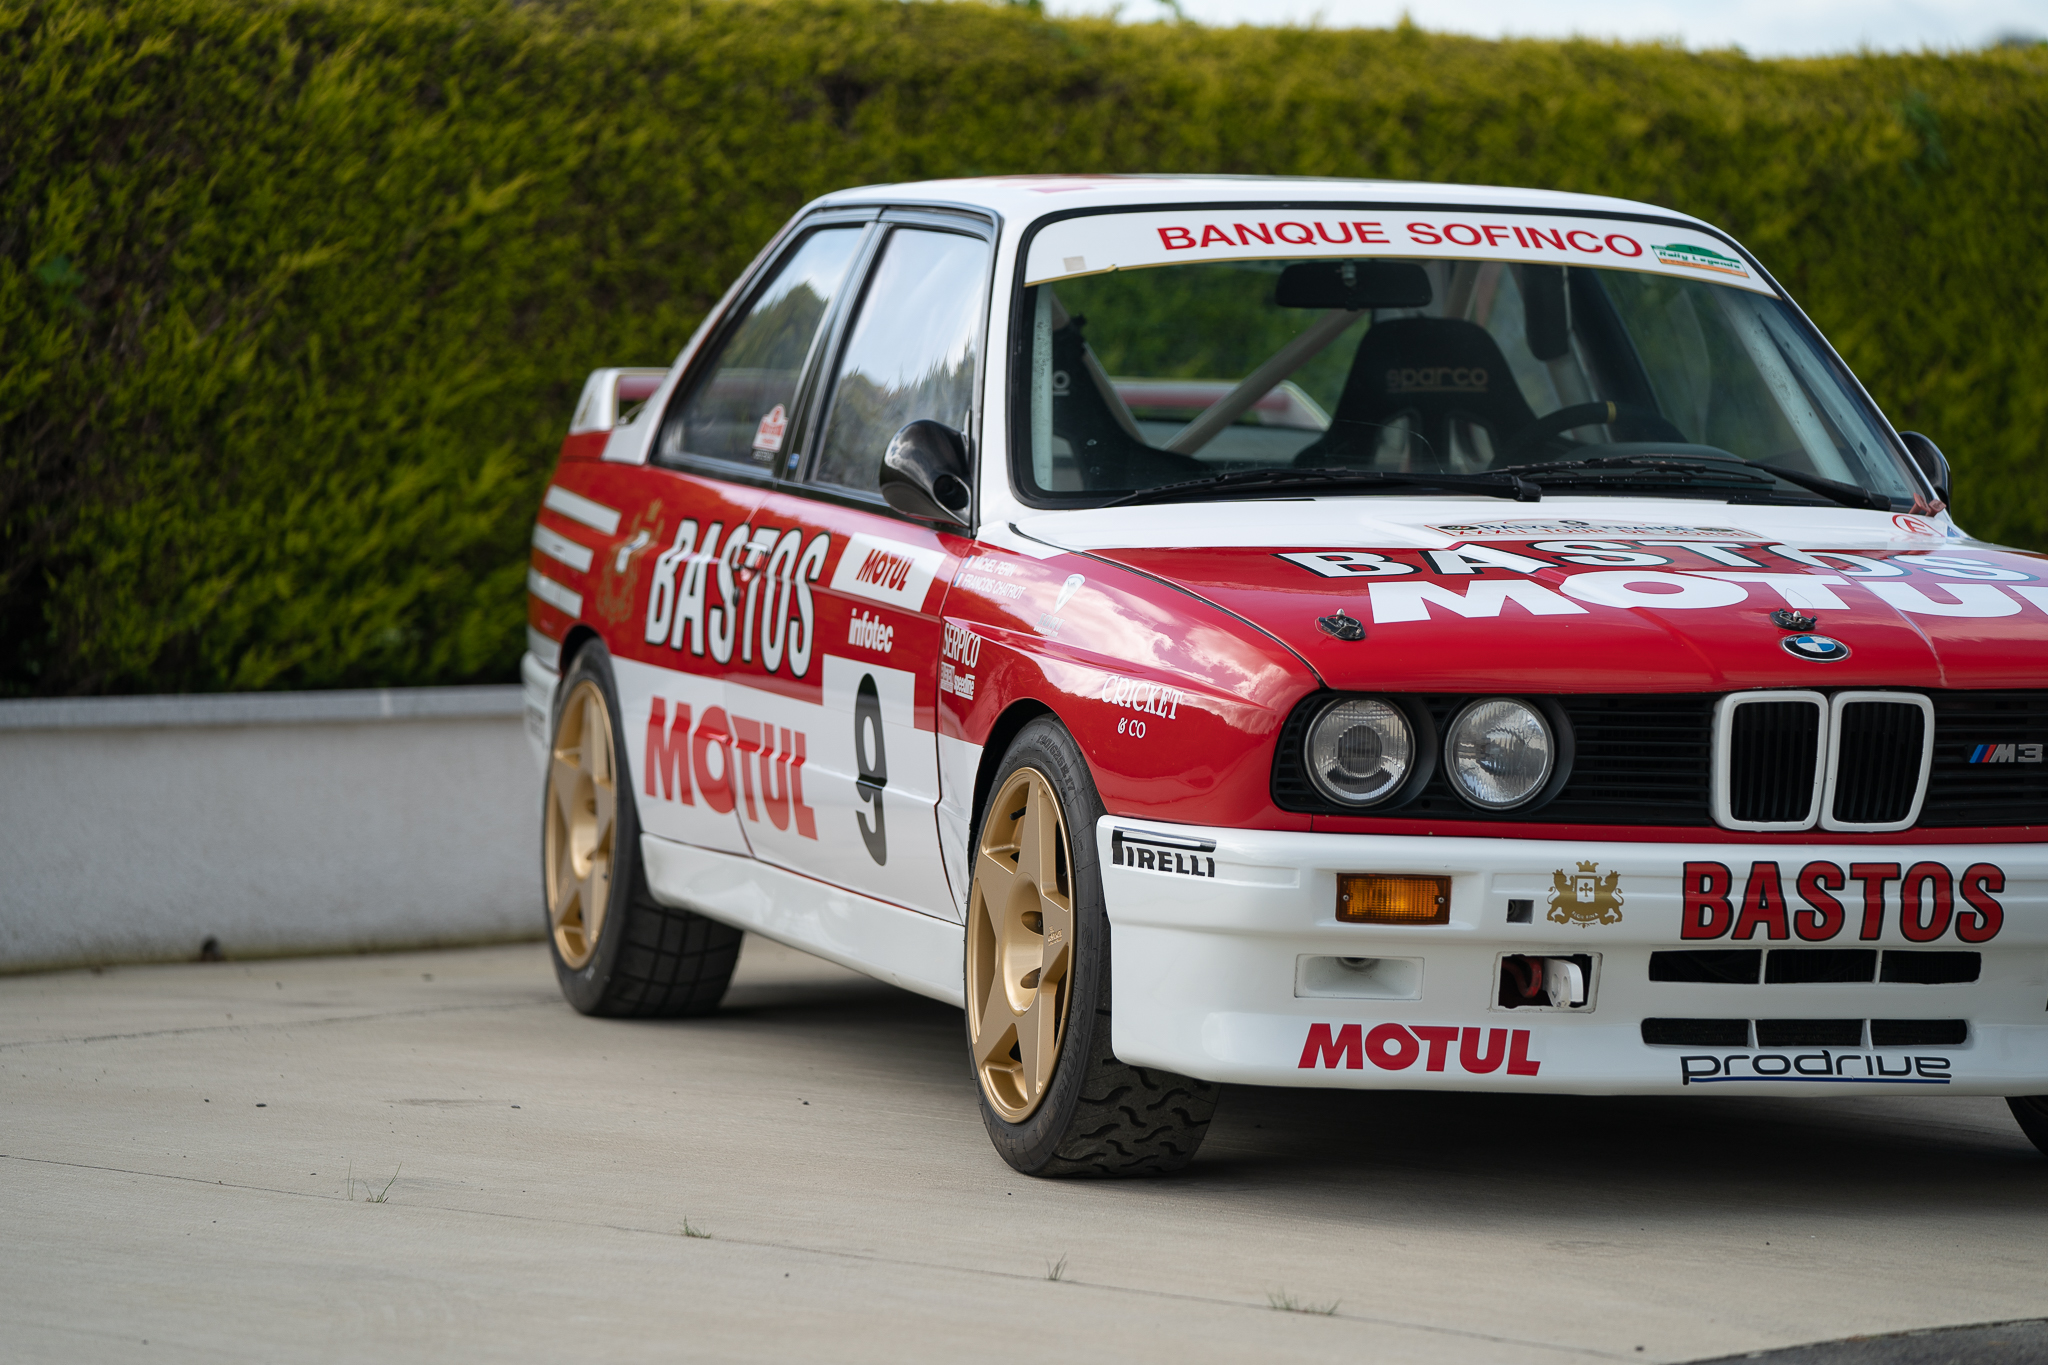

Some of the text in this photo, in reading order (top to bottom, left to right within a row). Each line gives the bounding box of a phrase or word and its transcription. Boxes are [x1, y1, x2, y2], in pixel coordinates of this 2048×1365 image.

[1156, 221, 1643, 258] BANQUE SOFINCO
[1386, 366, 1489, 392] sparco
[856, 548, 916, 592] MOTUL
[1274, 540, 2040, 582] BASTOS
[644, 518, 831, 679] BASTOS
[848, 608, 894, 654] infotec
[942, 622, 981, 669] SERPICO
[1101, 675, 1184, 720] CRICKET
[1117, 717, 1147, 739] & CO
[645, 695, 818, 841] MOTUL
[855, 673, 887, 867] 9
[1111, 826, 1217, 878] PIRELLI
[1680, 860, 2006, 943] BASTOS
[1297, 1022, 1541, 1076] MOTUL
[1680, 1049, 1952, 1086] prodrive
